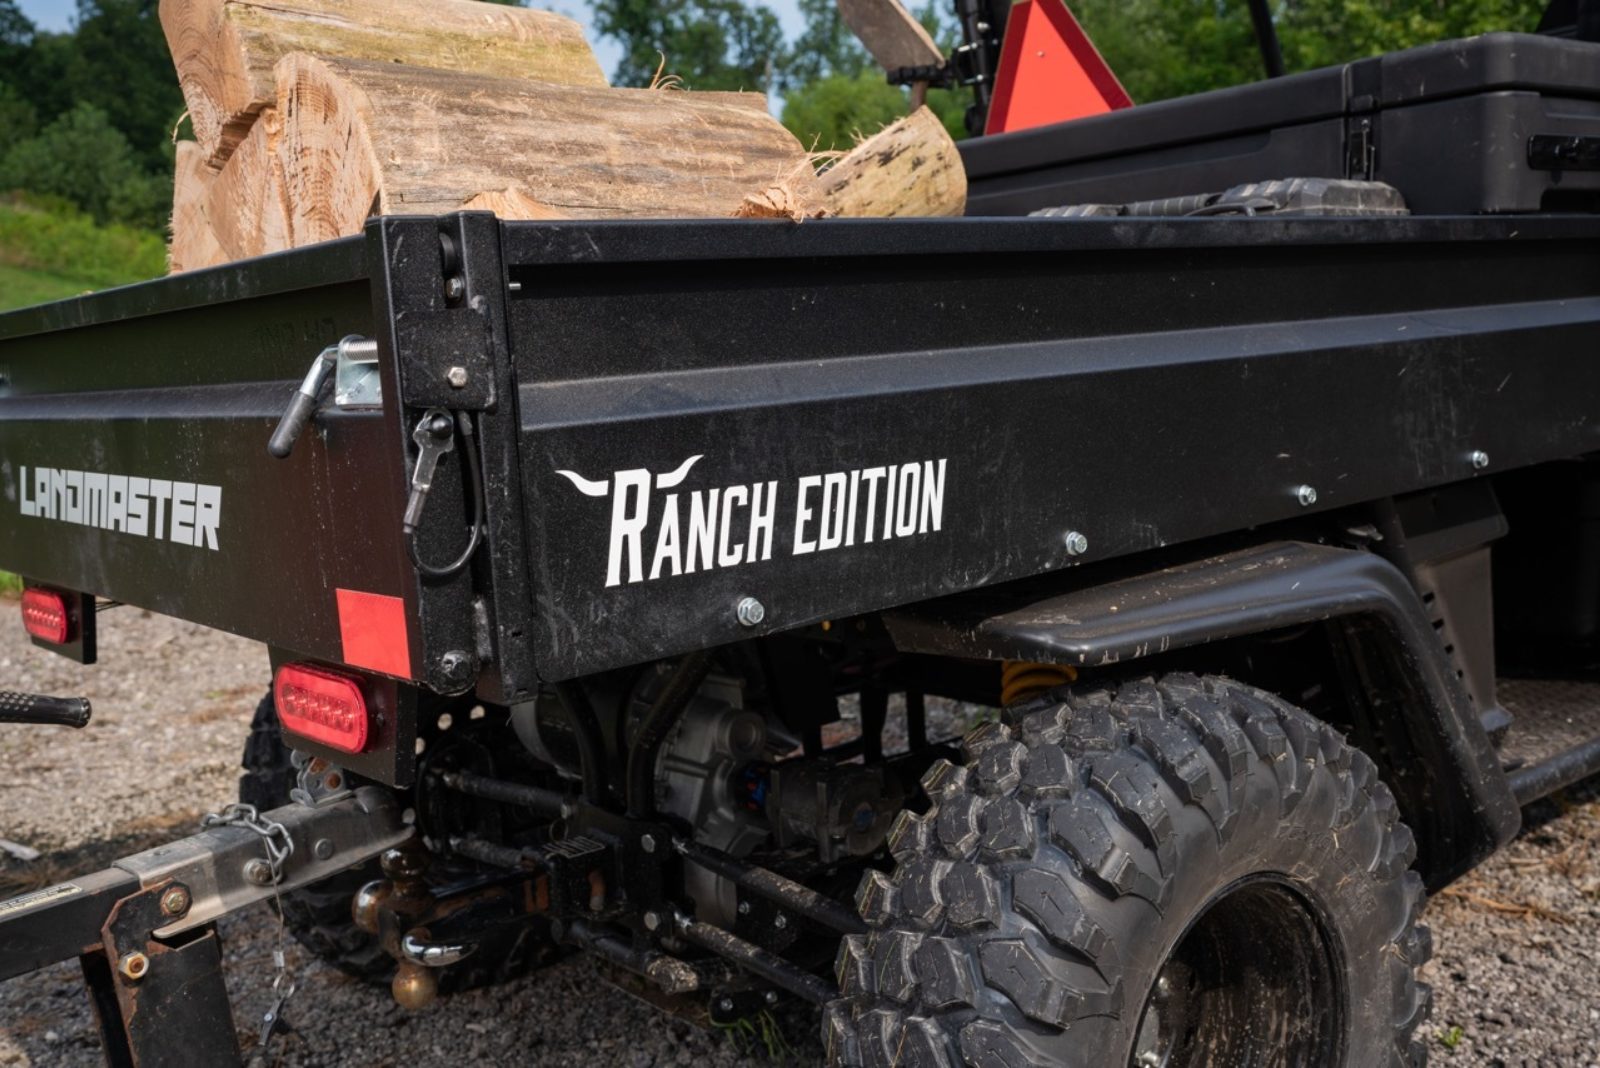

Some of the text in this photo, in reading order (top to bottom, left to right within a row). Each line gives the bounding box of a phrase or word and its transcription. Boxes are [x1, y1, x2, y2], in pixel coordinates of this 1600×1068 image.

[20, 466, 222, 551] LANDMASTER
[605, 458, 948, 587] RANCH EDITION
